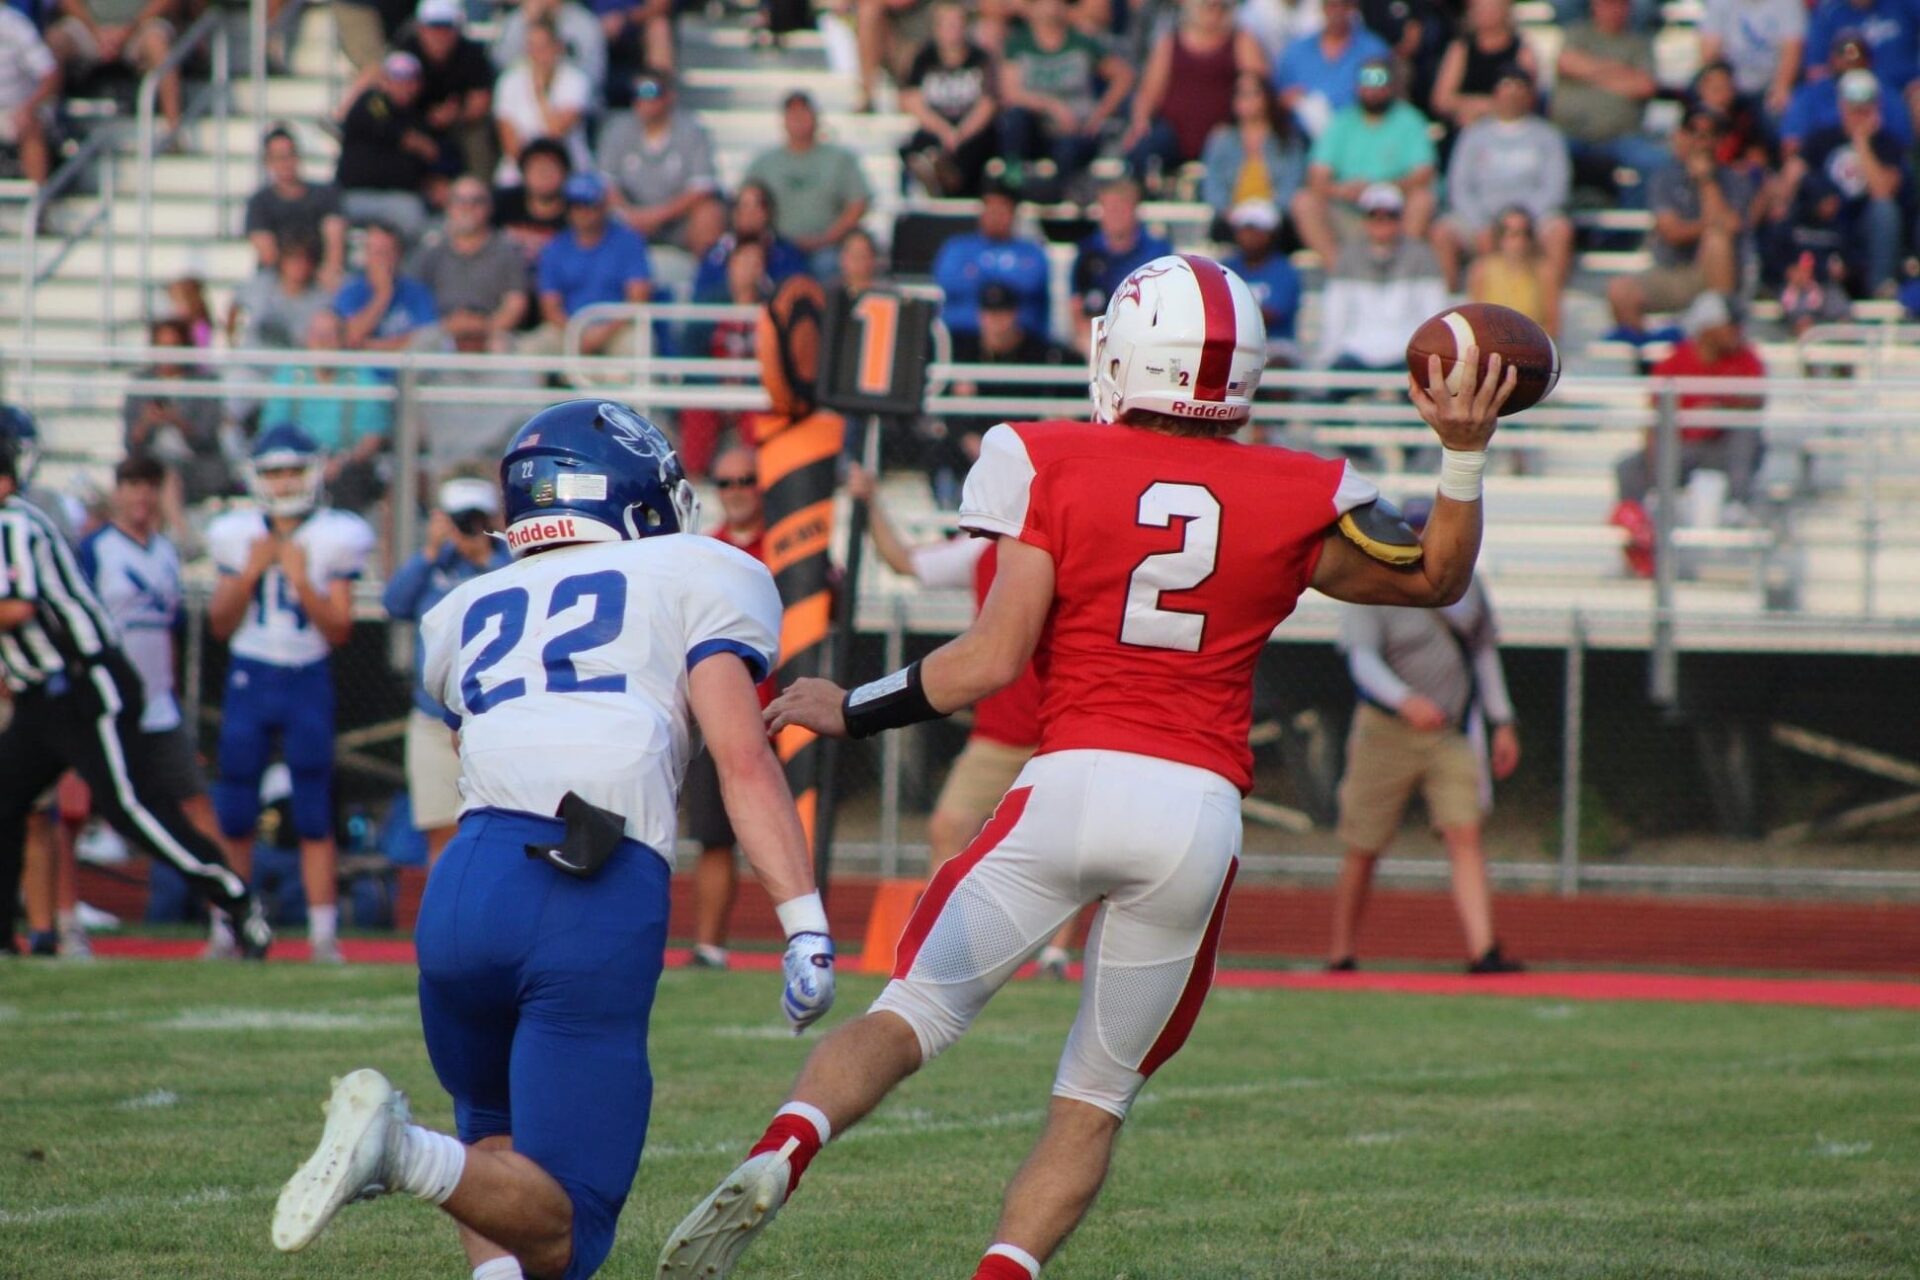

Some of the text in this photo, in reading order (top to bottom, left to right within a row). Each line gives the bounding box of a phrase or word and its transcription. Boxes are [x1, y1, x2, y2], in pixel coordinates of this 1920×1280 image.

[854, 292, 898, 395] 1
[1179, 371, 1189, 386] 2
[1172, 401, 1238, 419] Riddell
[522, 461, 534, 478] 22
[507, 519, 575, 549] Riddell
[1119, 480, 1222, 653] 2
[461, 569, 627, 715] 22
